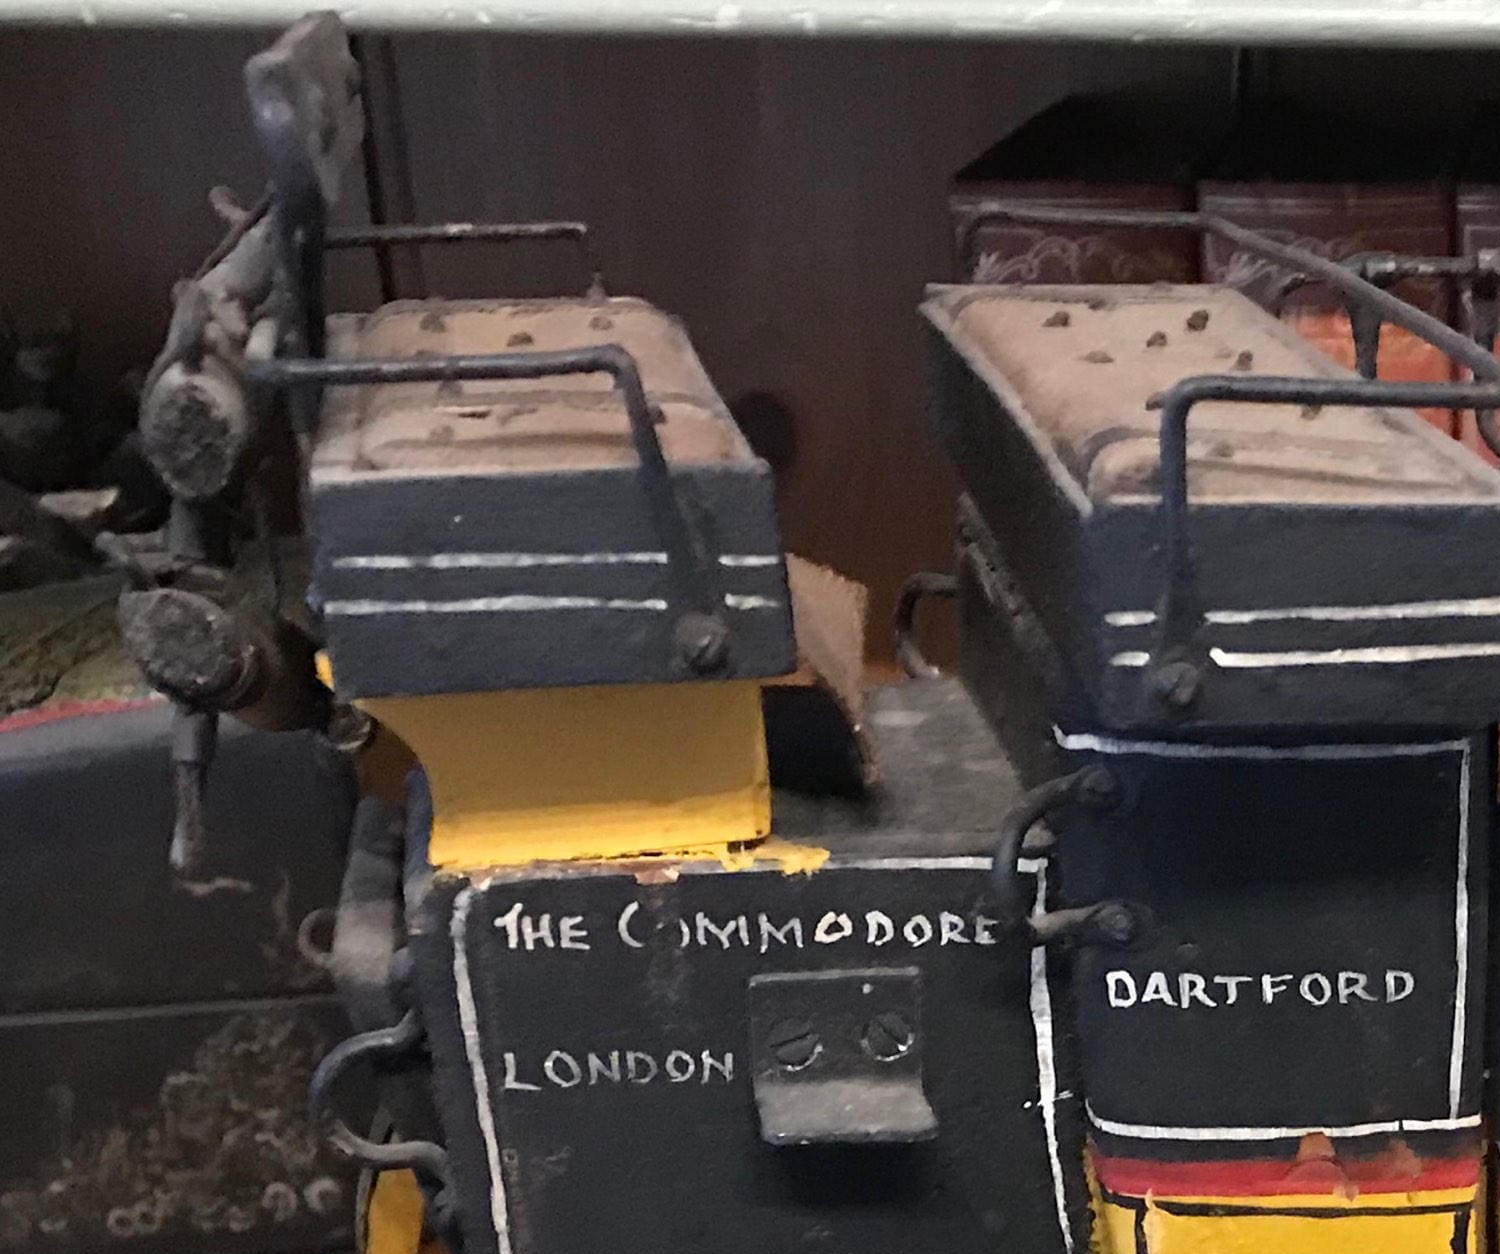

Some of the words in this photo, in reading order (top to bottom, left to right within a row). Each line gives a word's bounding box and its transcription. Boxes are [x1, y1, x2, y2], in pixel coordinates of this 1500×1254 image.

[495, 903, 591, 950] THE
[1105, 969, 1415, 1008] DARTFORD
[503, 1050, 735, 1090] LONDON
